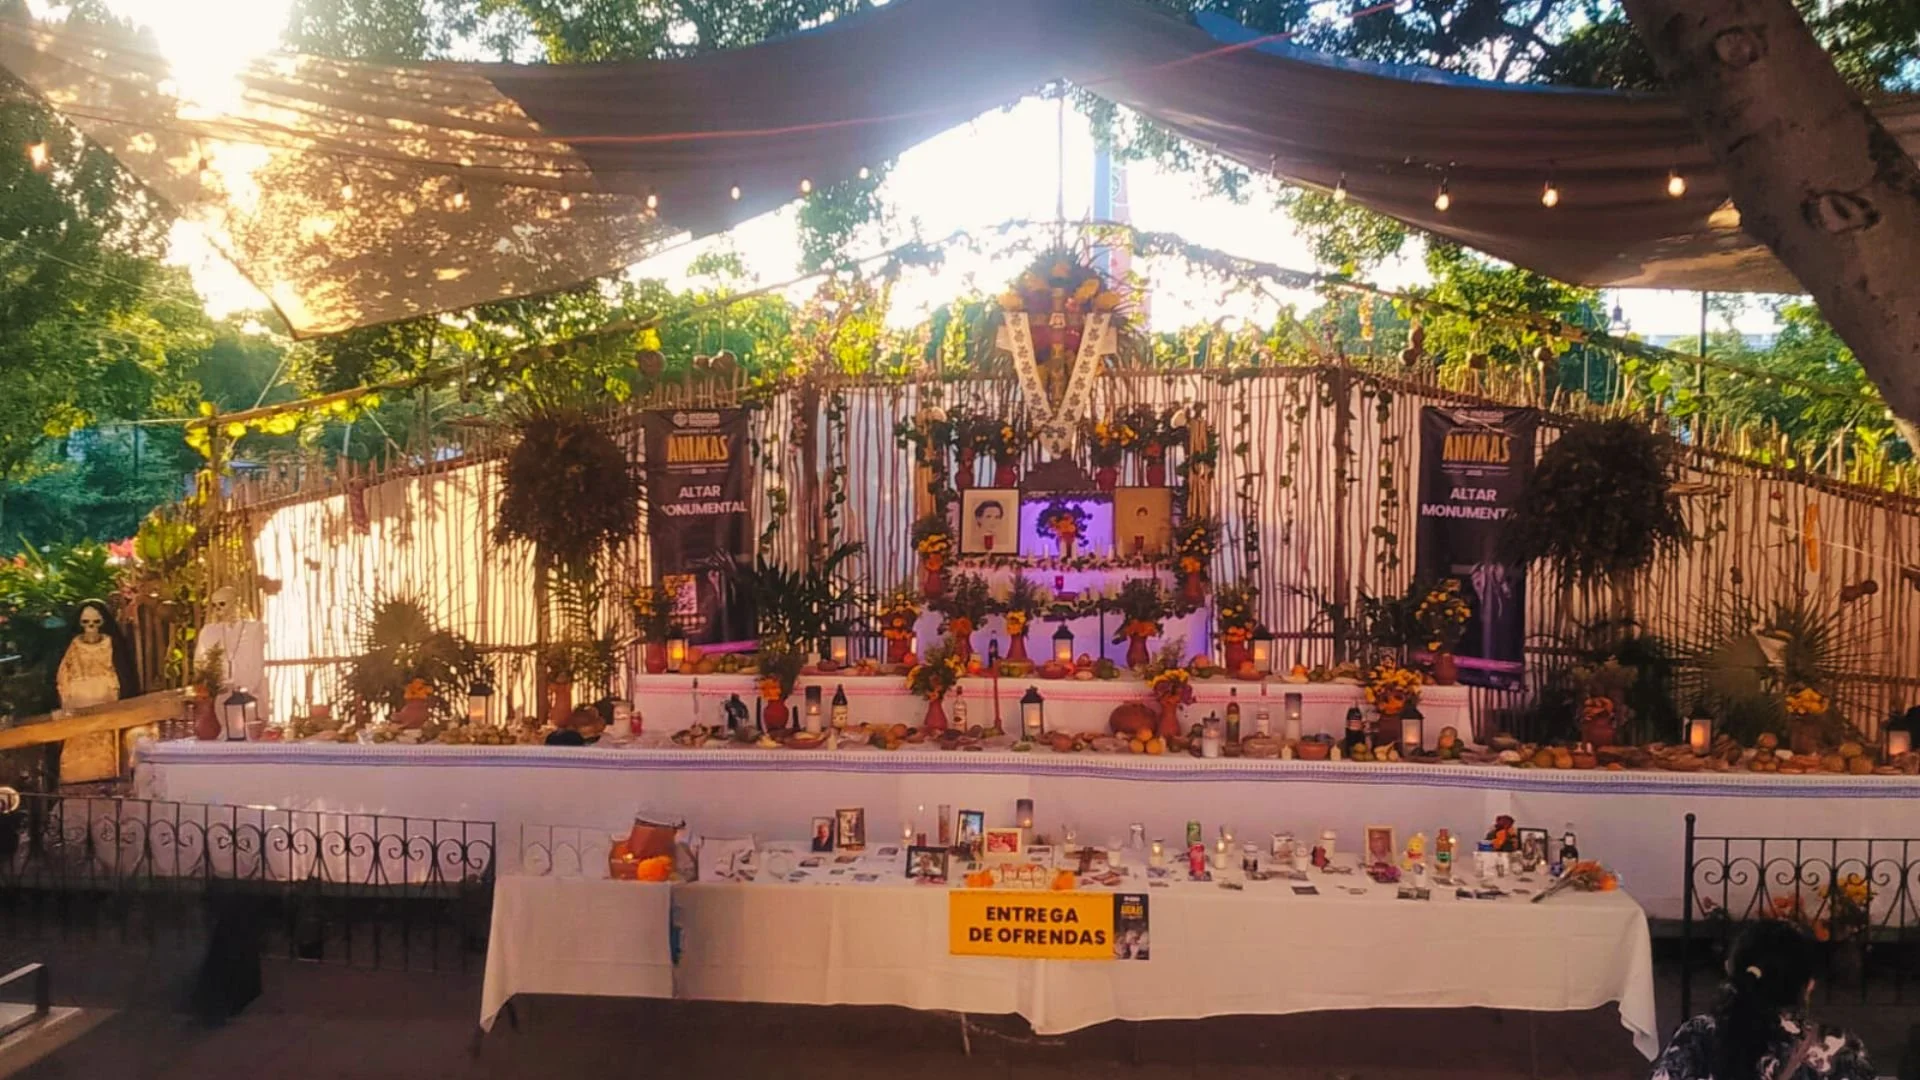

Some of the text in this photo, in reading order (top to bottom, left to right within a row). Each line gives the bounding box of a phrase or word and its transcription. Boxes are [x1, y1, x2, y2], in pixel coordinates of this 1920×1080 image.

[667, 434, 729, 462] ANIMAS
[1442, 434, 1511, 463] ANIMAS
[678, 485, 721, 499] ALTAR
[1450, 488, 1497, 501] ALTAR
[986, 906, 1079, 923] ENTREGA
[969, 927, 1106, 945] DE OFRENDAS
